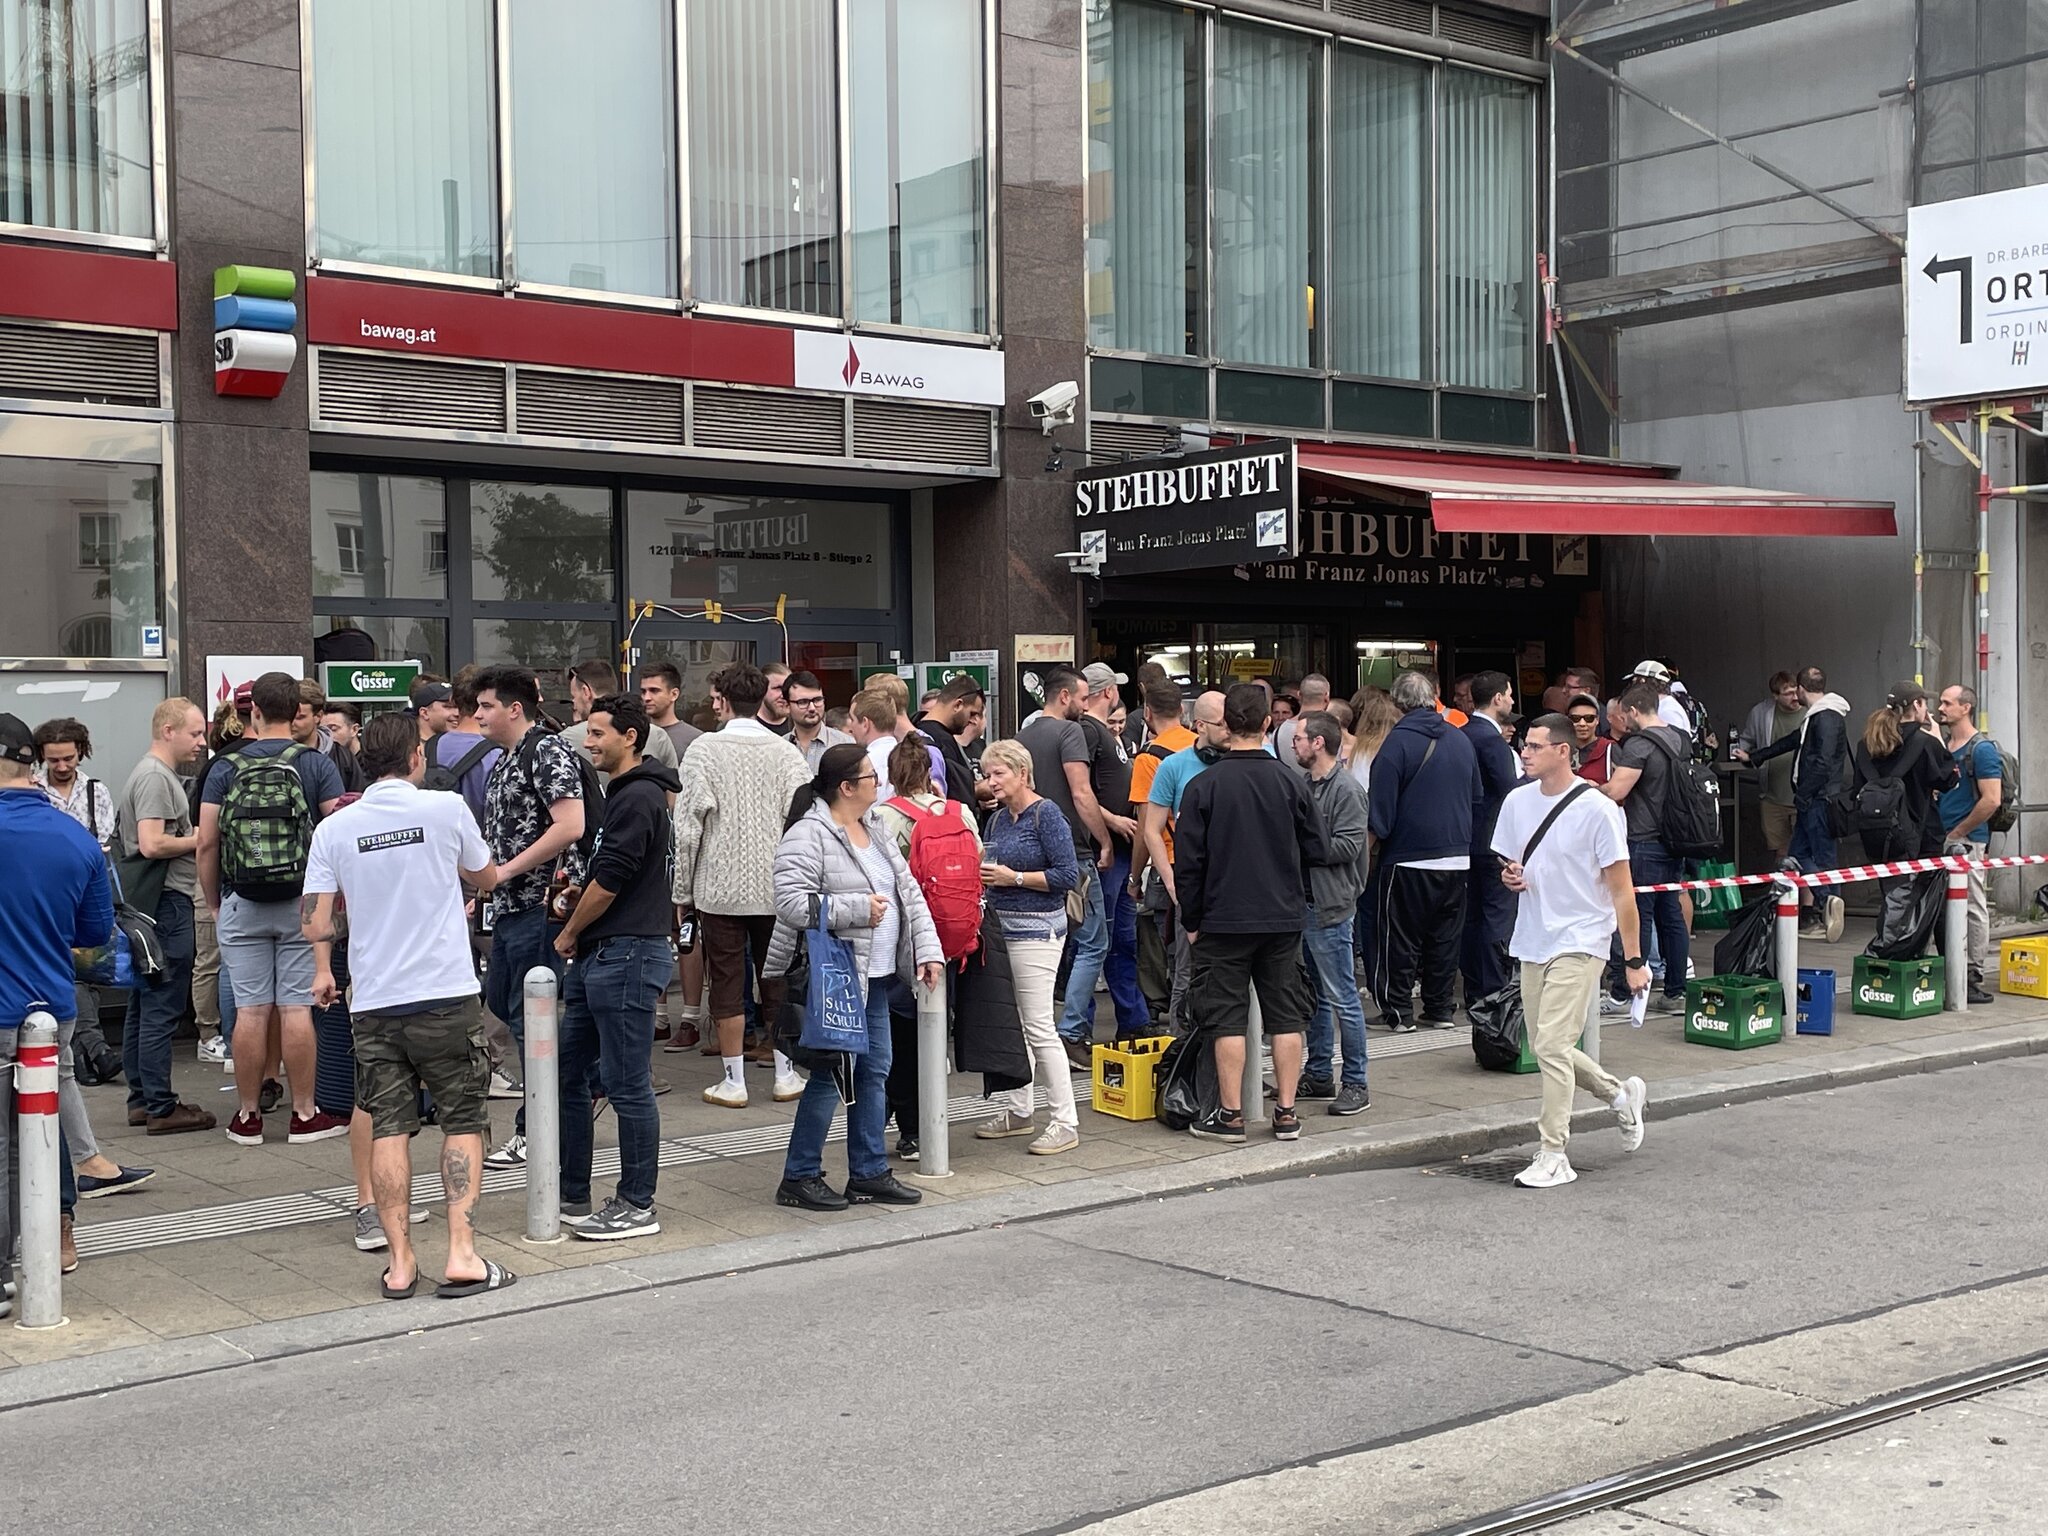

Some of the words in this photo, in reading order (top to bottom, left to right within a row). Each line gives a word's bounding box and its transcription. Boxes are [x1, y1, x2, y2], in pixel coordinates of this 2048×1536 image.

[360, 318, 436, 345] bawag.at
[215, 336, 234, 364] SB
[860, 371, 925, 389] BAWAG
[1076, 453, 1285, 517] STEHBUFFET
[1139, 533, 1174, 550] Franz
[1176, 529, 1211, 546] Jonas
[649, 545, 677, 556] 1210
[678, 546, 712, 559] Wien,
[714, 548, 746, 559] Franz
[748, 550, 781, 561] Jonas
[784, 550, 810, 561] Platz
[829, 552, 863, 565] Stiege
[865, 554, 873, 563] 2
[1252, 561, 1296, 580] "am
[1304, 560, 1366, 583] Franz
[1372, 564, 1430, 584] Jonas
[1438, 565, 1498, 586] Platz"
[1105, 617, 1178, 635] POMMES
[351, 670, 396, 692] Gösser
[360, 829, 421, 847] STEHBUFFET
[1859, 984, 1895, 1004] Gösser
[1912, 986, 1936, 1006] Gösser
[1692, 1011, 1729, 1031] Gösser
[1748, 1014, 1774, 1035] Gösser
